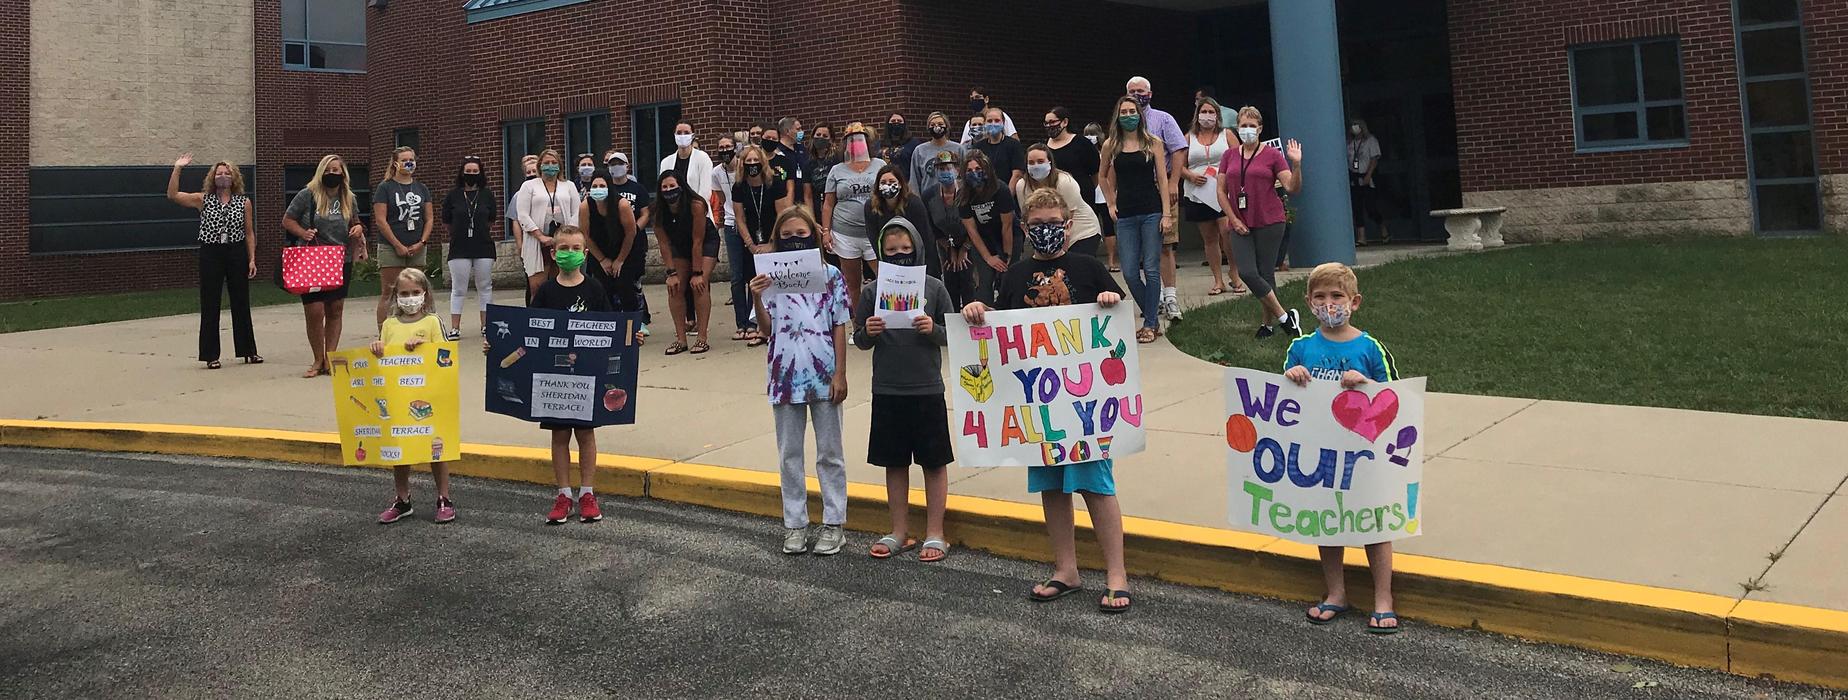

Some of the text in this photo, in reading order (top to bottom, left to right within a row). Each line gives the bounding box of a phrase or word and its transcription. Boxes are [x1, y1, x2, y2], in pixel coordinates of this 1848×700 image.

[850, 183, 872, 195] Pitt
[769, 269, 811, 281] Welcome
[531, 319, 615, 330] BEST TEACHERS
[527, 337, 611, 347] IN THE WORLD!
[969, 315, 1112, 368] THANK
[380, 357, 422, 366] TEACHERS
[399, 377, 424, 386] BEST!
[539, 380, 590, 390] THANK YOU
[1012, 362, 1094, 404] YOU
[541, 391, 587, 401] SHERIDAN
[543, 402, 585, 412] TERRACE!
[1235, 377, 1301, 427] We
[963, 394, 1143, 448] 4 ALL YOU
[392, 426, 431, 435] TERRACE
[1243, 481, 1420, 537] Teachers!
